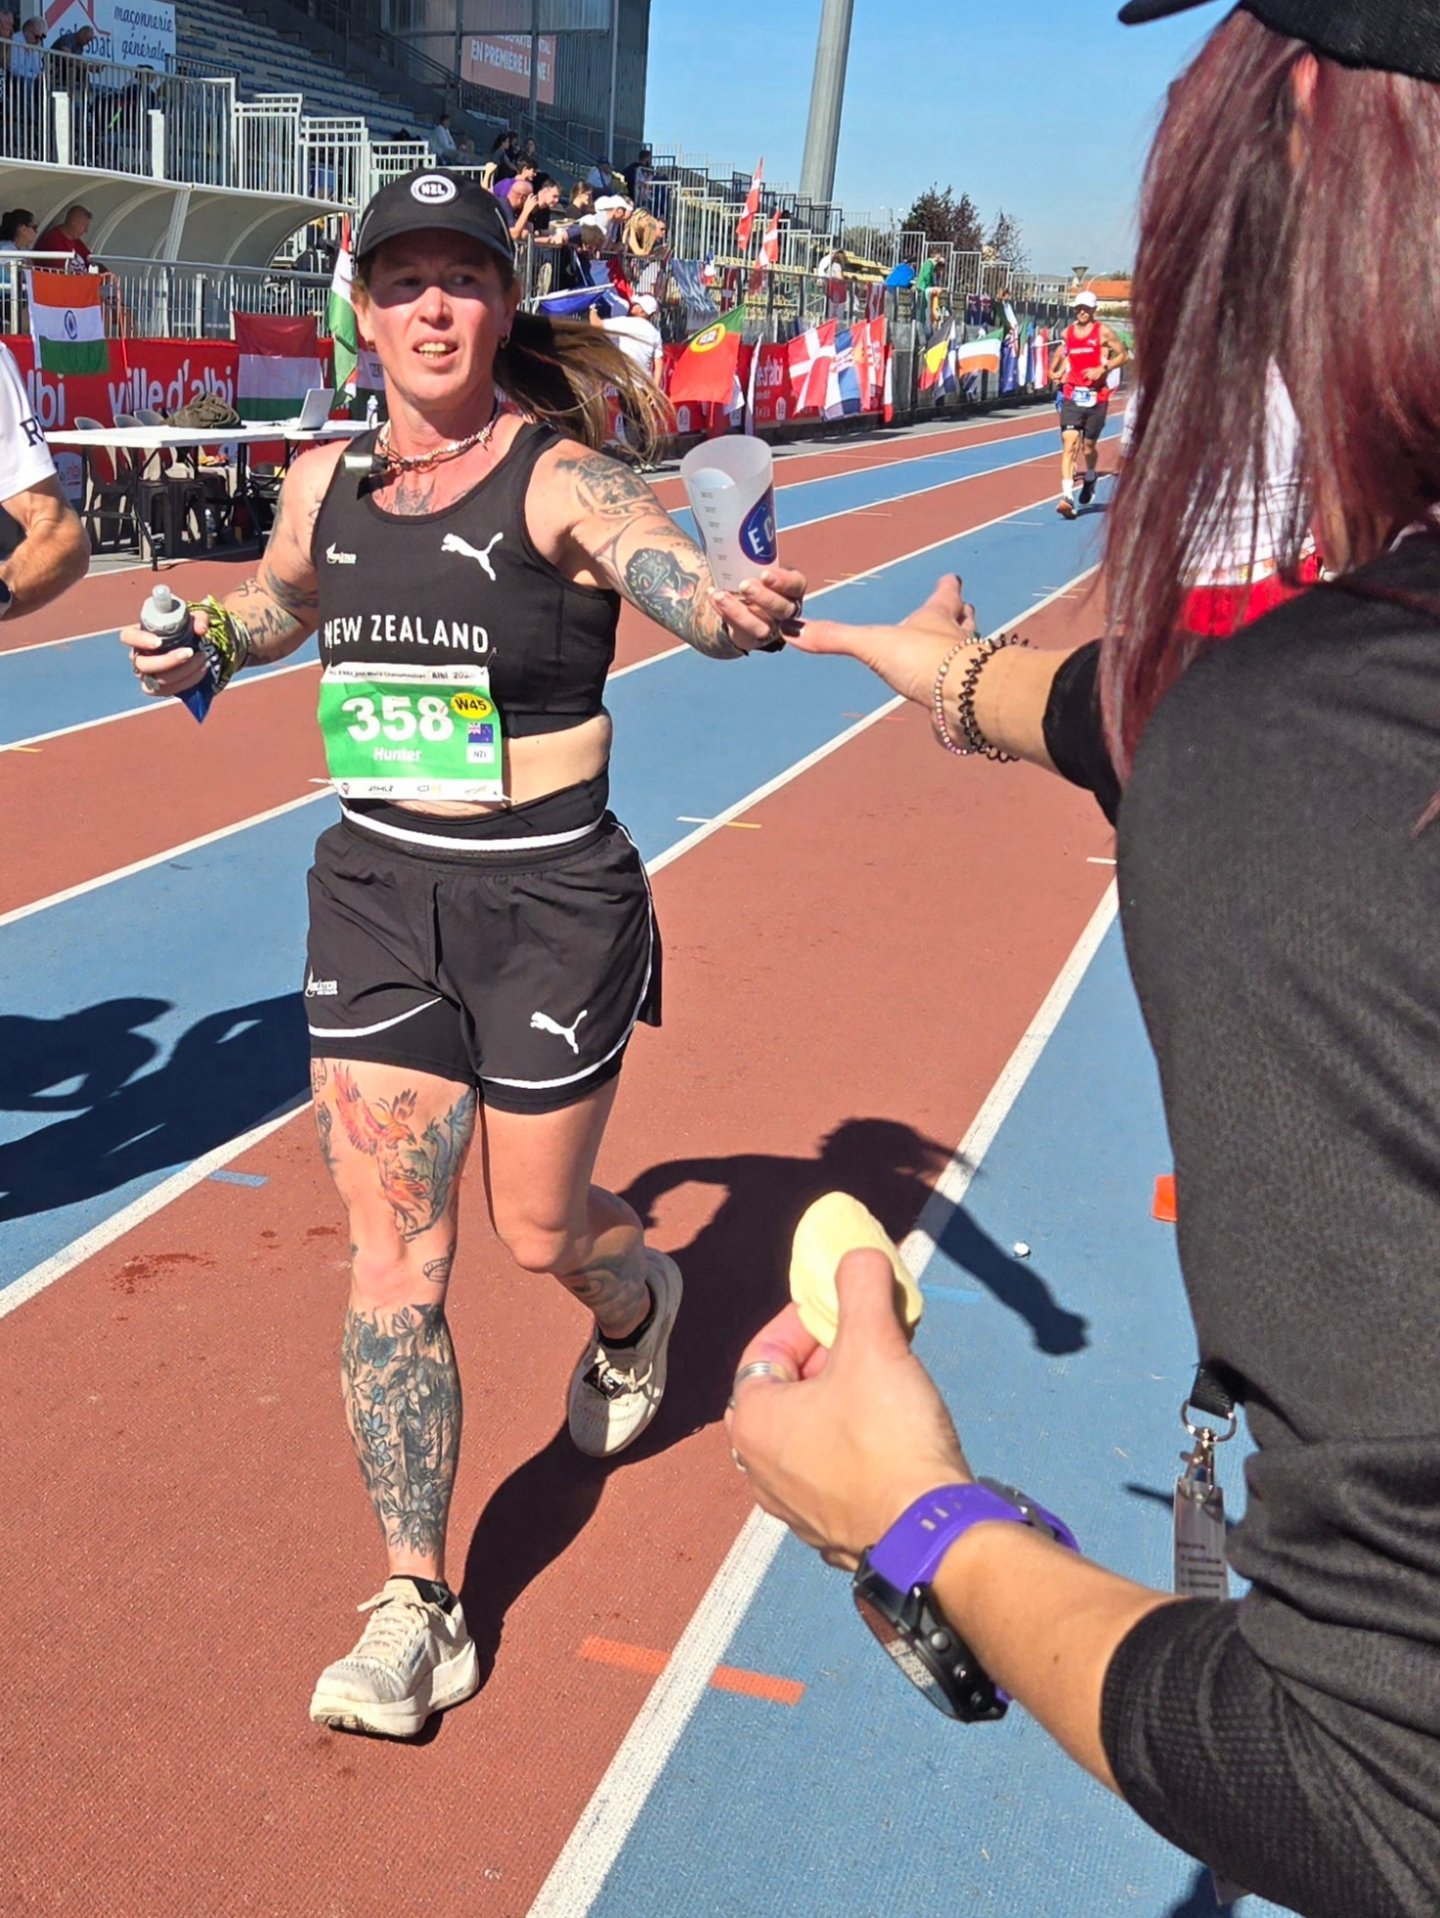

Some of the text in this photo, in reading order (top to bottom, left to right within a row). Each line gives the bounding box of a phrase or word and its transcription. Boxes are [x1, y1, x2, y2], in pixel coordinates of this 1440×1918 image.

[114, 6, 174, 33] maçonnerie
[471, 39, 483, 62] EN
[421, 183, 446, 195] NZL
[324, 614, 489, 653] NEW ZEALAND
[455, 698, 487, 711] W45
[341, 695, 454, 741] 358
